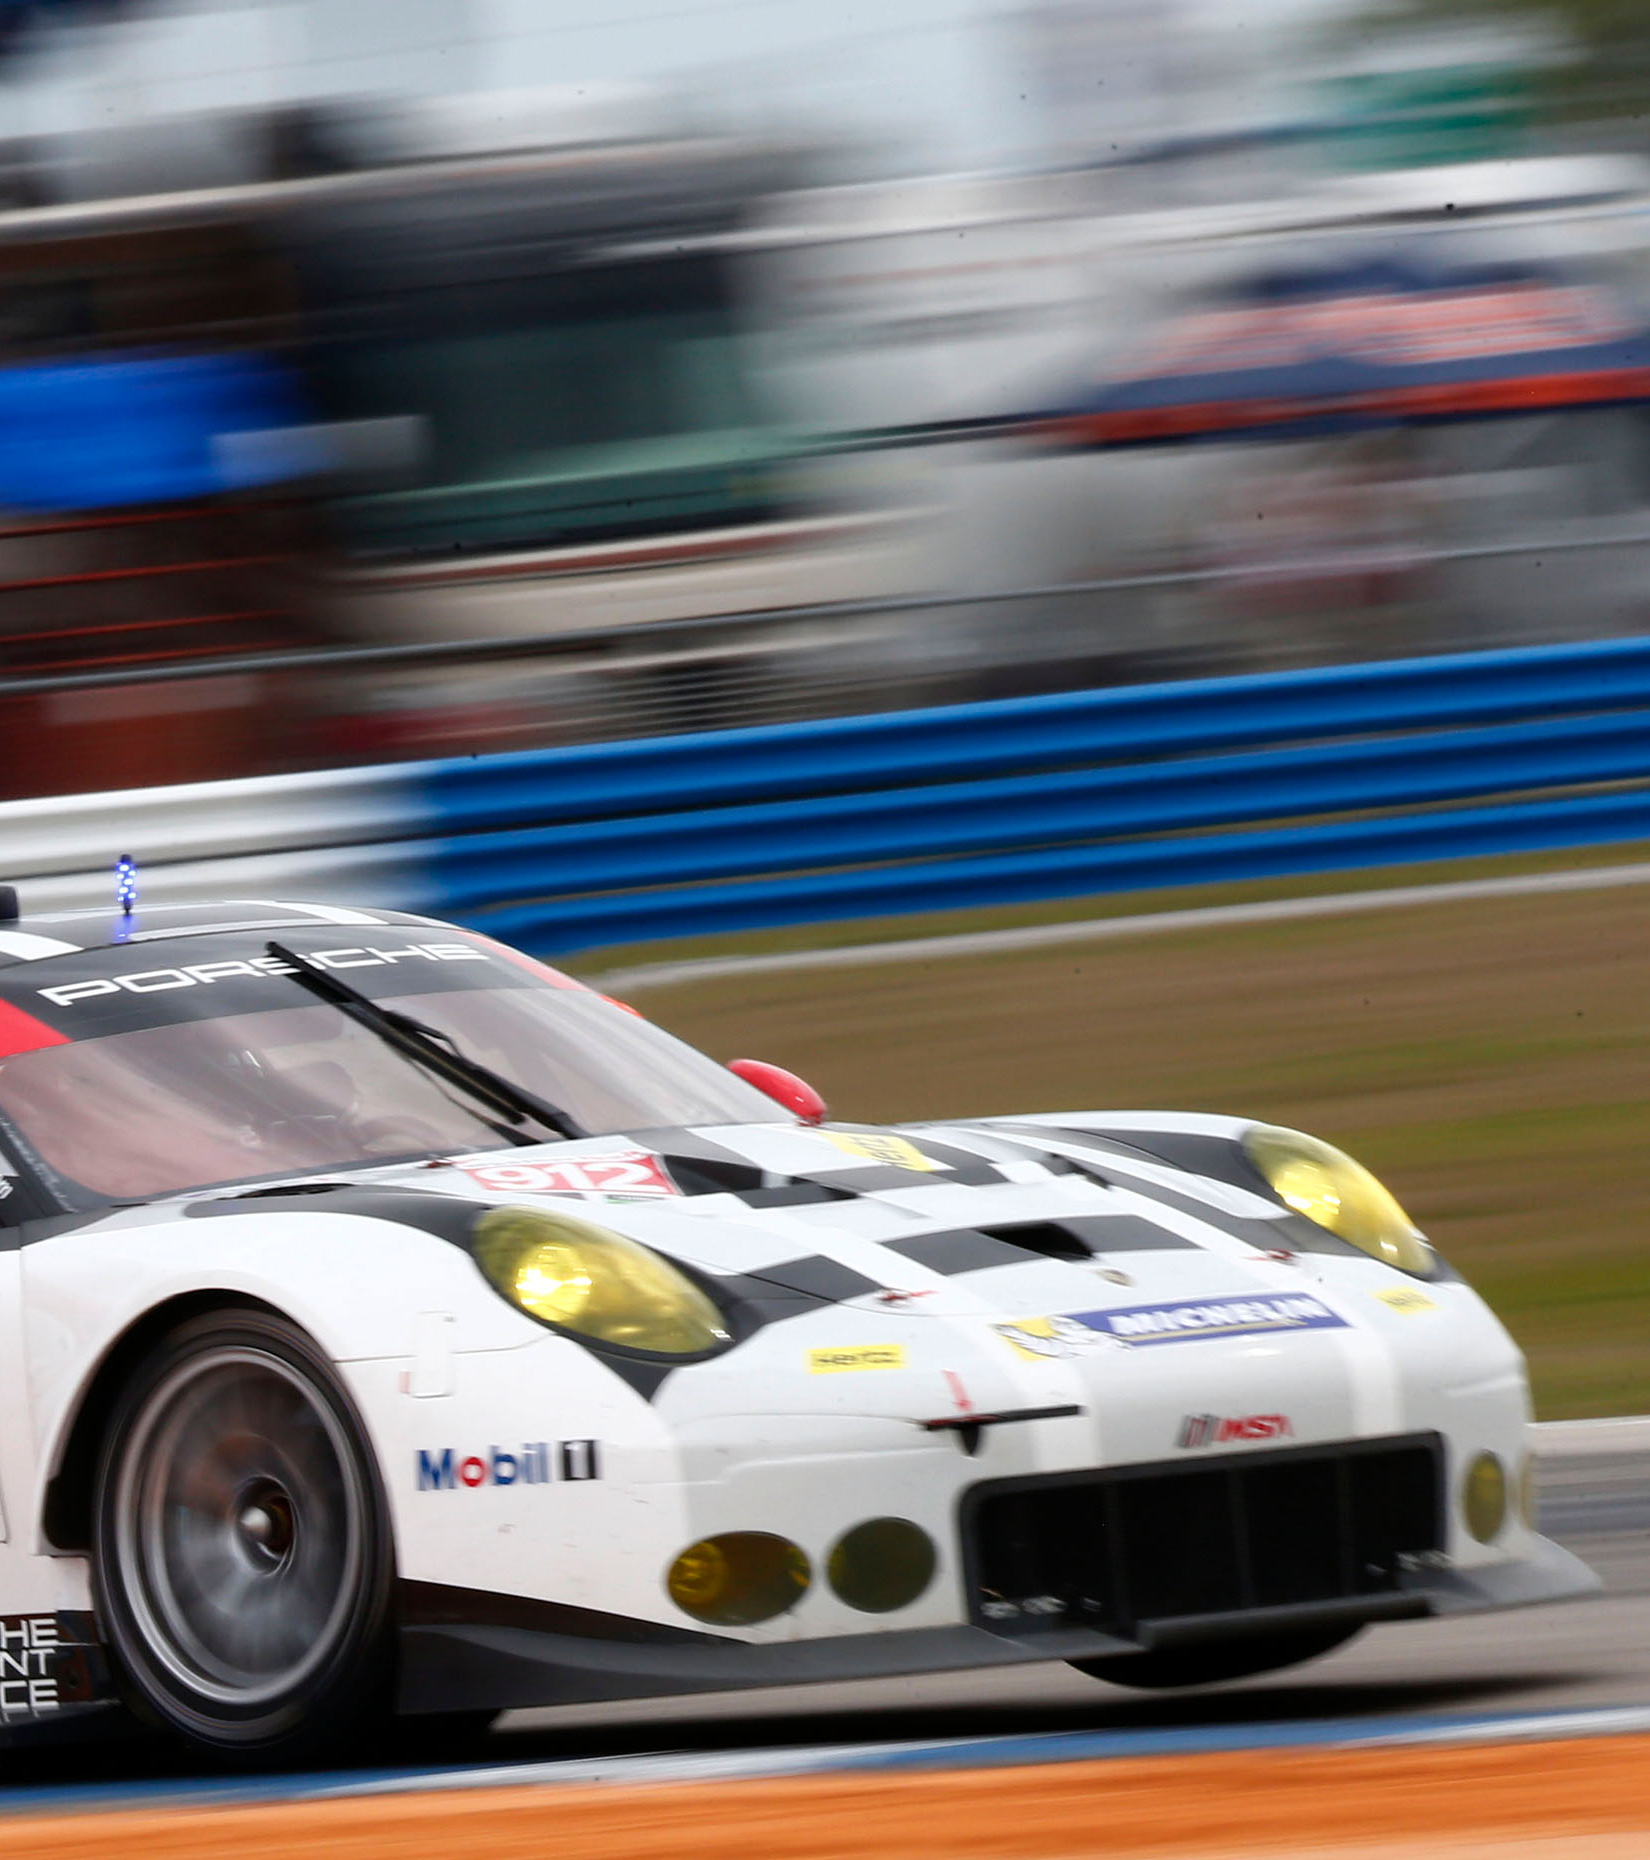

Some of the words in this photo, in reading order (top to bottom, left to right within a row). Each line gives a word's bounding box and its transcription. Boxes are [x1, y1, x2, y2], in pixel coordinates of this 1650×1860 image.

[36, 942, 490, 1006] PORSCHE
[475, 1162, 668, 1193] 912
[1107, 1298, 1333, 1335] MICHELIN
[416, 1442, 550, 1491] Mobil
